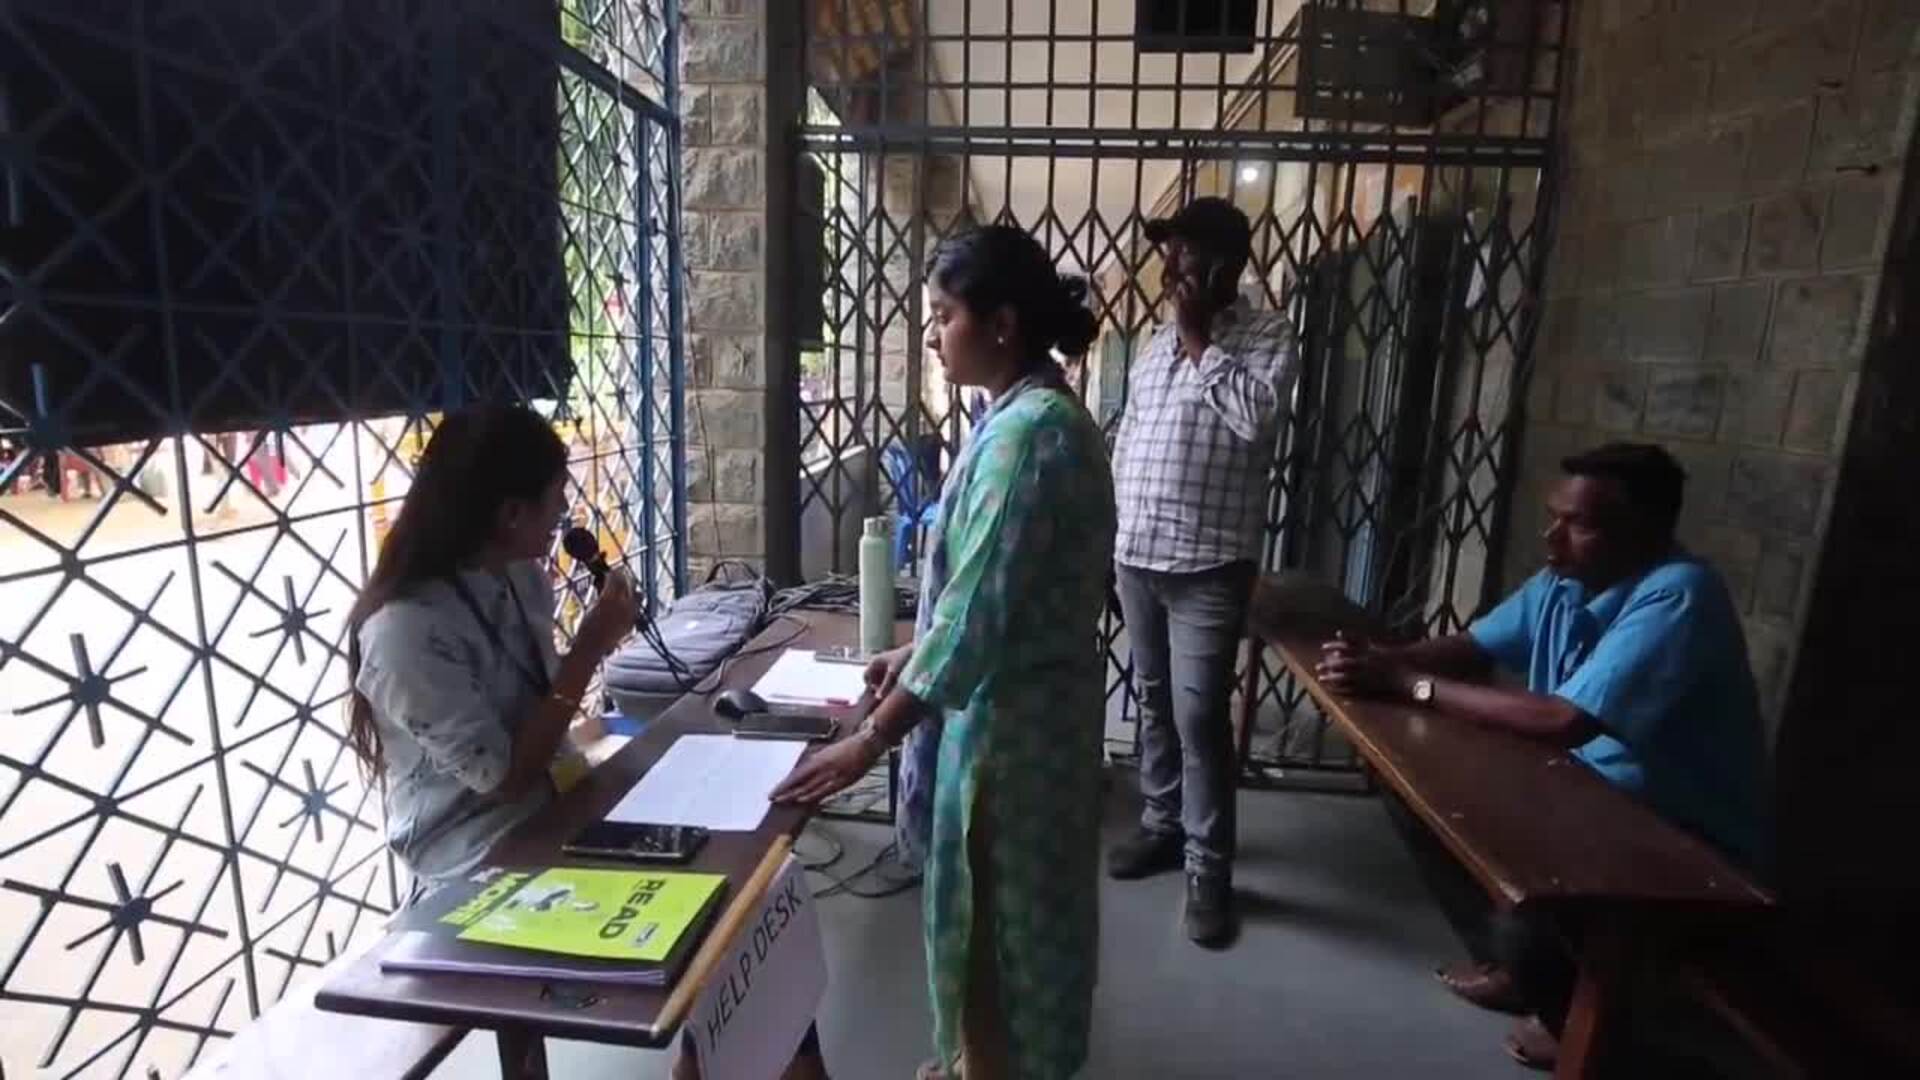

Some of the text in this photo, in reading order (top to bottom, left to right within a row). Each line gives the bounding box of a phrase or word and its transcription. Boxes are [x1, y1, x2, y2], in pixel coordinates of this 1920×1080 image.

[599, 879, 667, 938] READ
[706, 876, 802, 1051] HELP DESK
